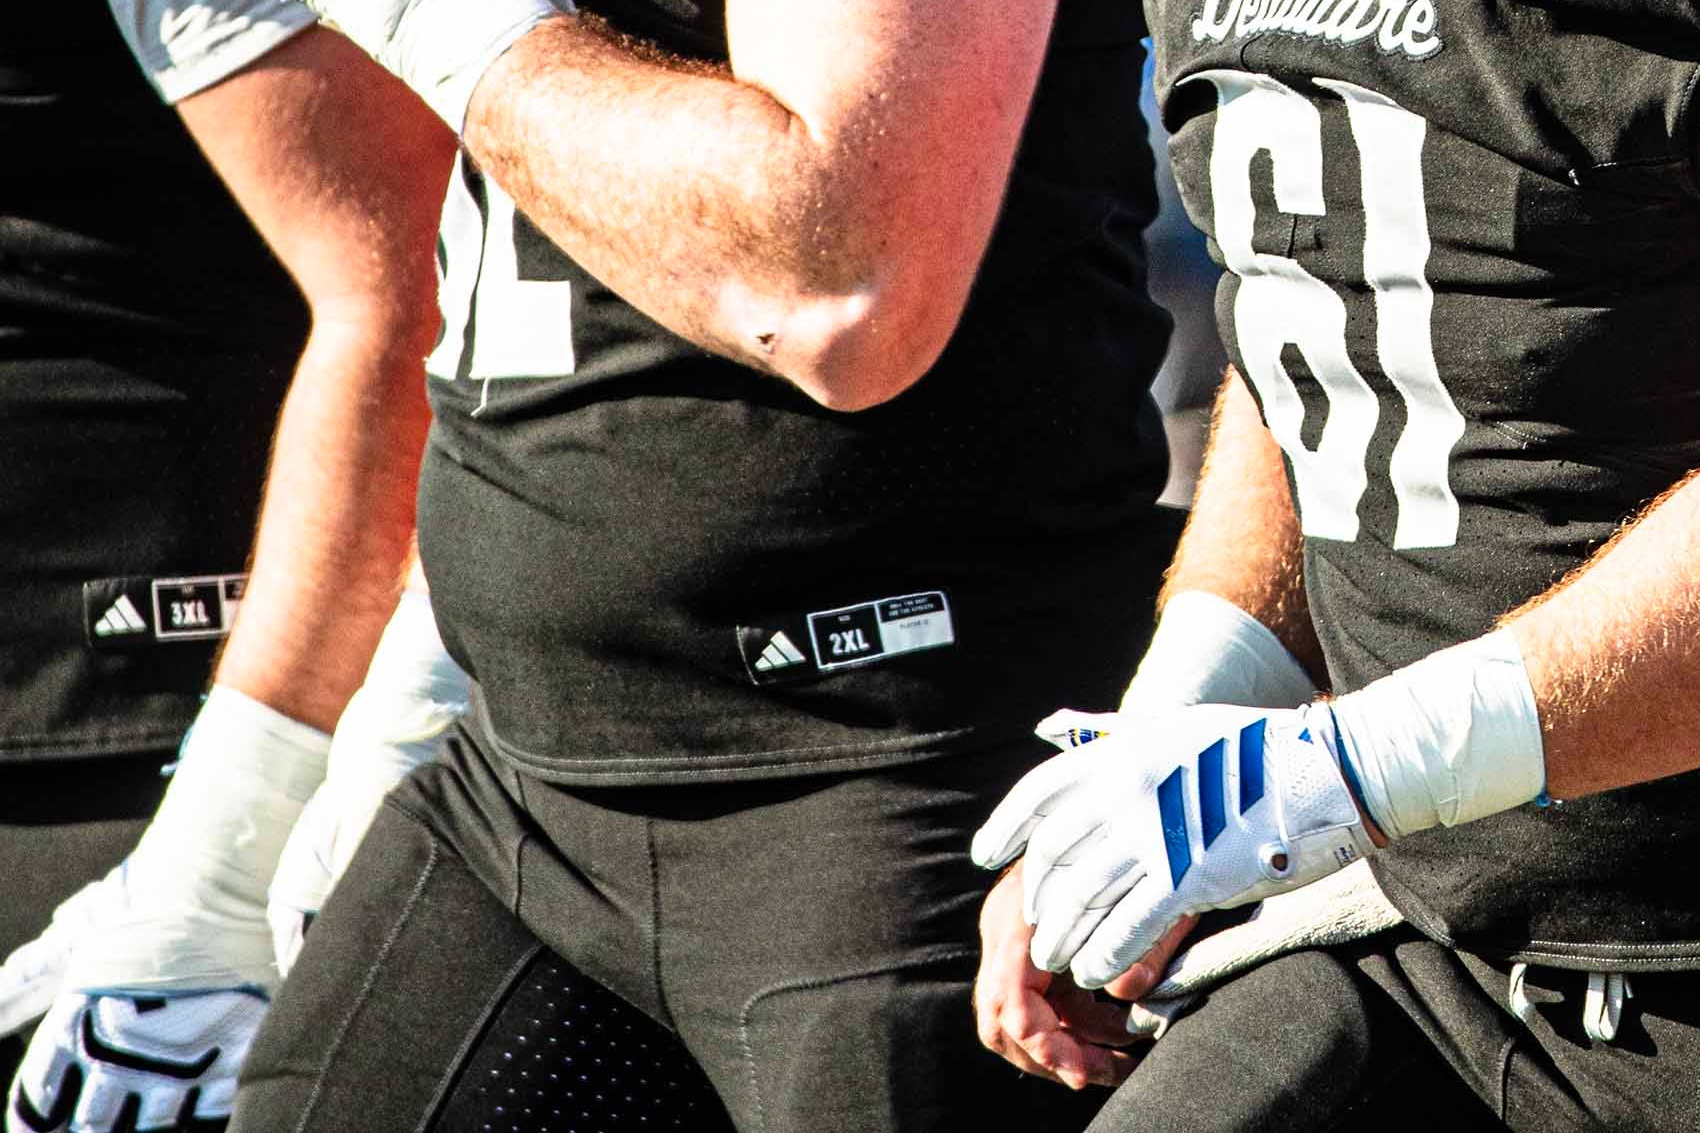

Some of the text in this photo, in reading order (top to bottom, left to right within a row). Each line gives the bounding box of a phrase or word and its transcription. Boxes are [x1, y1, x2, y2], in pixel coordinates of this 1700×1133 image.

[1174, 68, 1467, 551] 61
[170, 599, 209, 627] 3XL
[829, 628, 870, 656] 2XL
